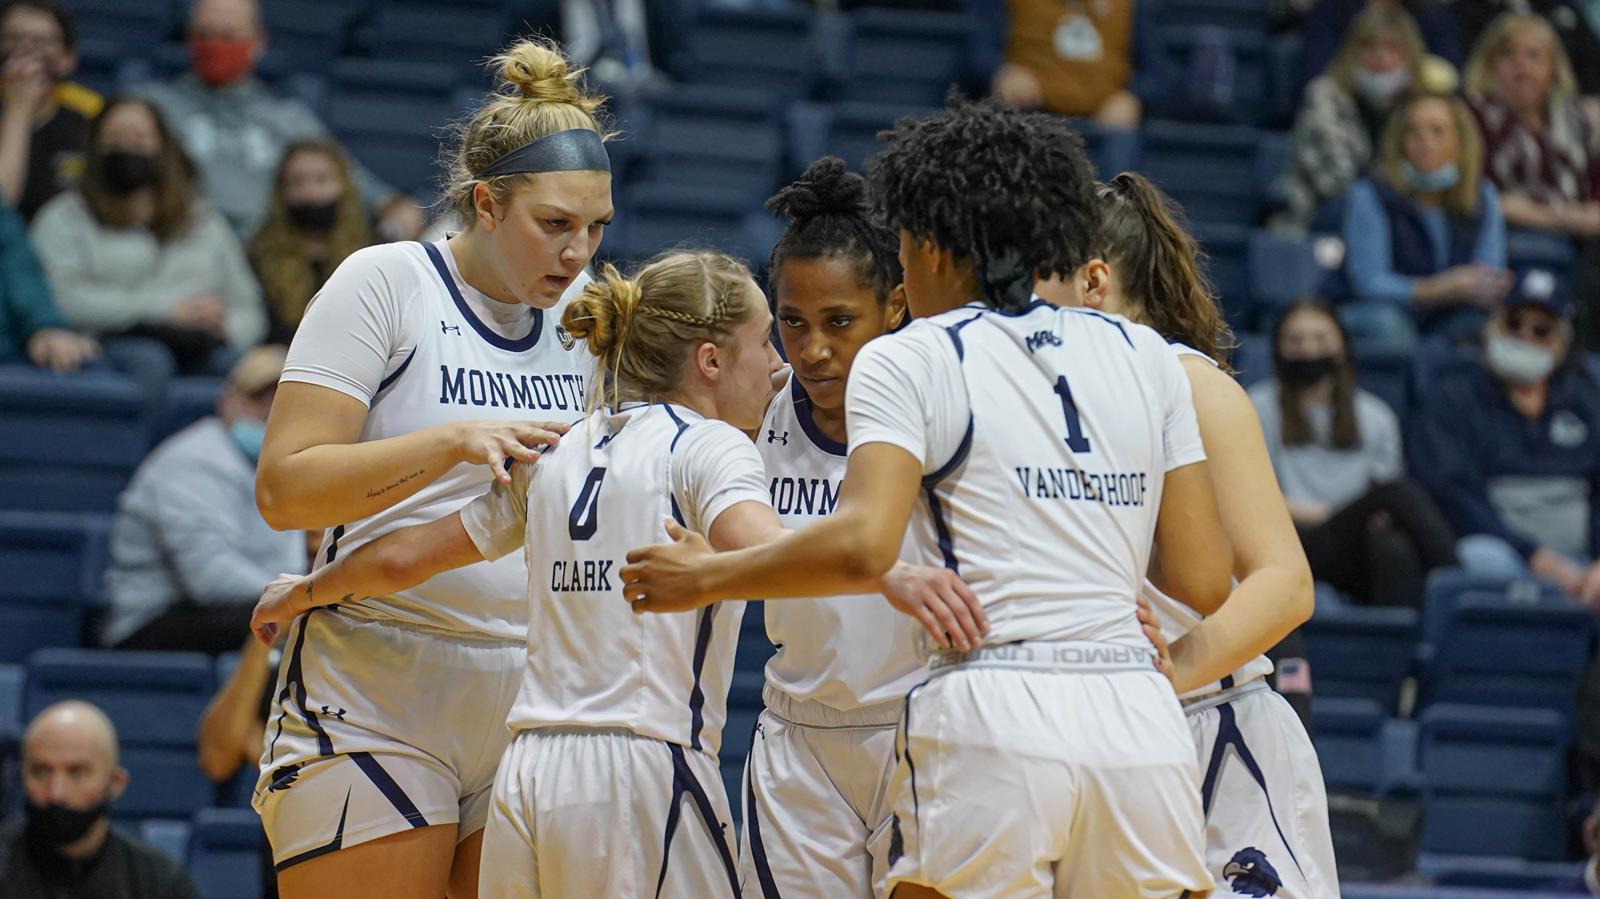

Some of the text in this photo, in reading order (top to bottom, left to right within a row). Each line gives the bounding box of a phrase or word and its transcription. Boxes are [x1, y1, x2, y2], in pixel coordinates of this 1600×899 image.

[440, 365, 584, 412] MONMOUTH
[1053, 375, 1091, 453] 1
[569, 467, 607, 541] 0
[551, 560, 613, 592] CLARK
